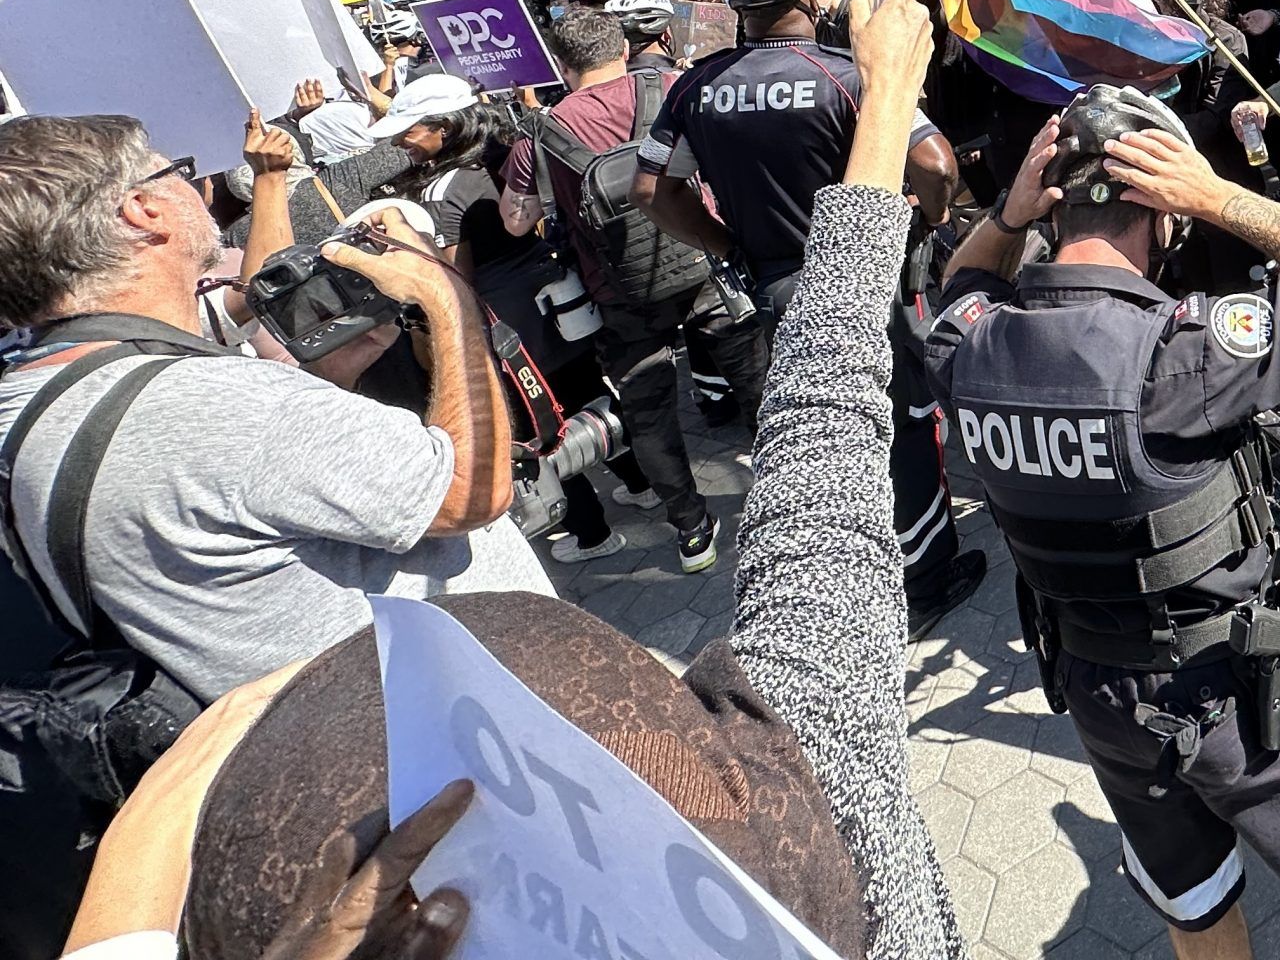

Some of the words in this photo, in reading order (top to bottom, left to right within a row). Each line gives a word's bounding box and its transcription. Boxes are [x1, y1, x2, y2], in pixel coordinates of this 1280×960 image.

[437, 8, 516, 56] PPC
[470, 62, 507, 75] CANADA
[494, 48, 522, 61] PARTY
[699, 80, 817, 114] POLICE
[1215, 302, 1231, 344] TORONTO
[1259, 309, 1273, 343] POLICE
[517, 366, 543, 399] EOS
[958, 408, 1116, 480] POLICE
